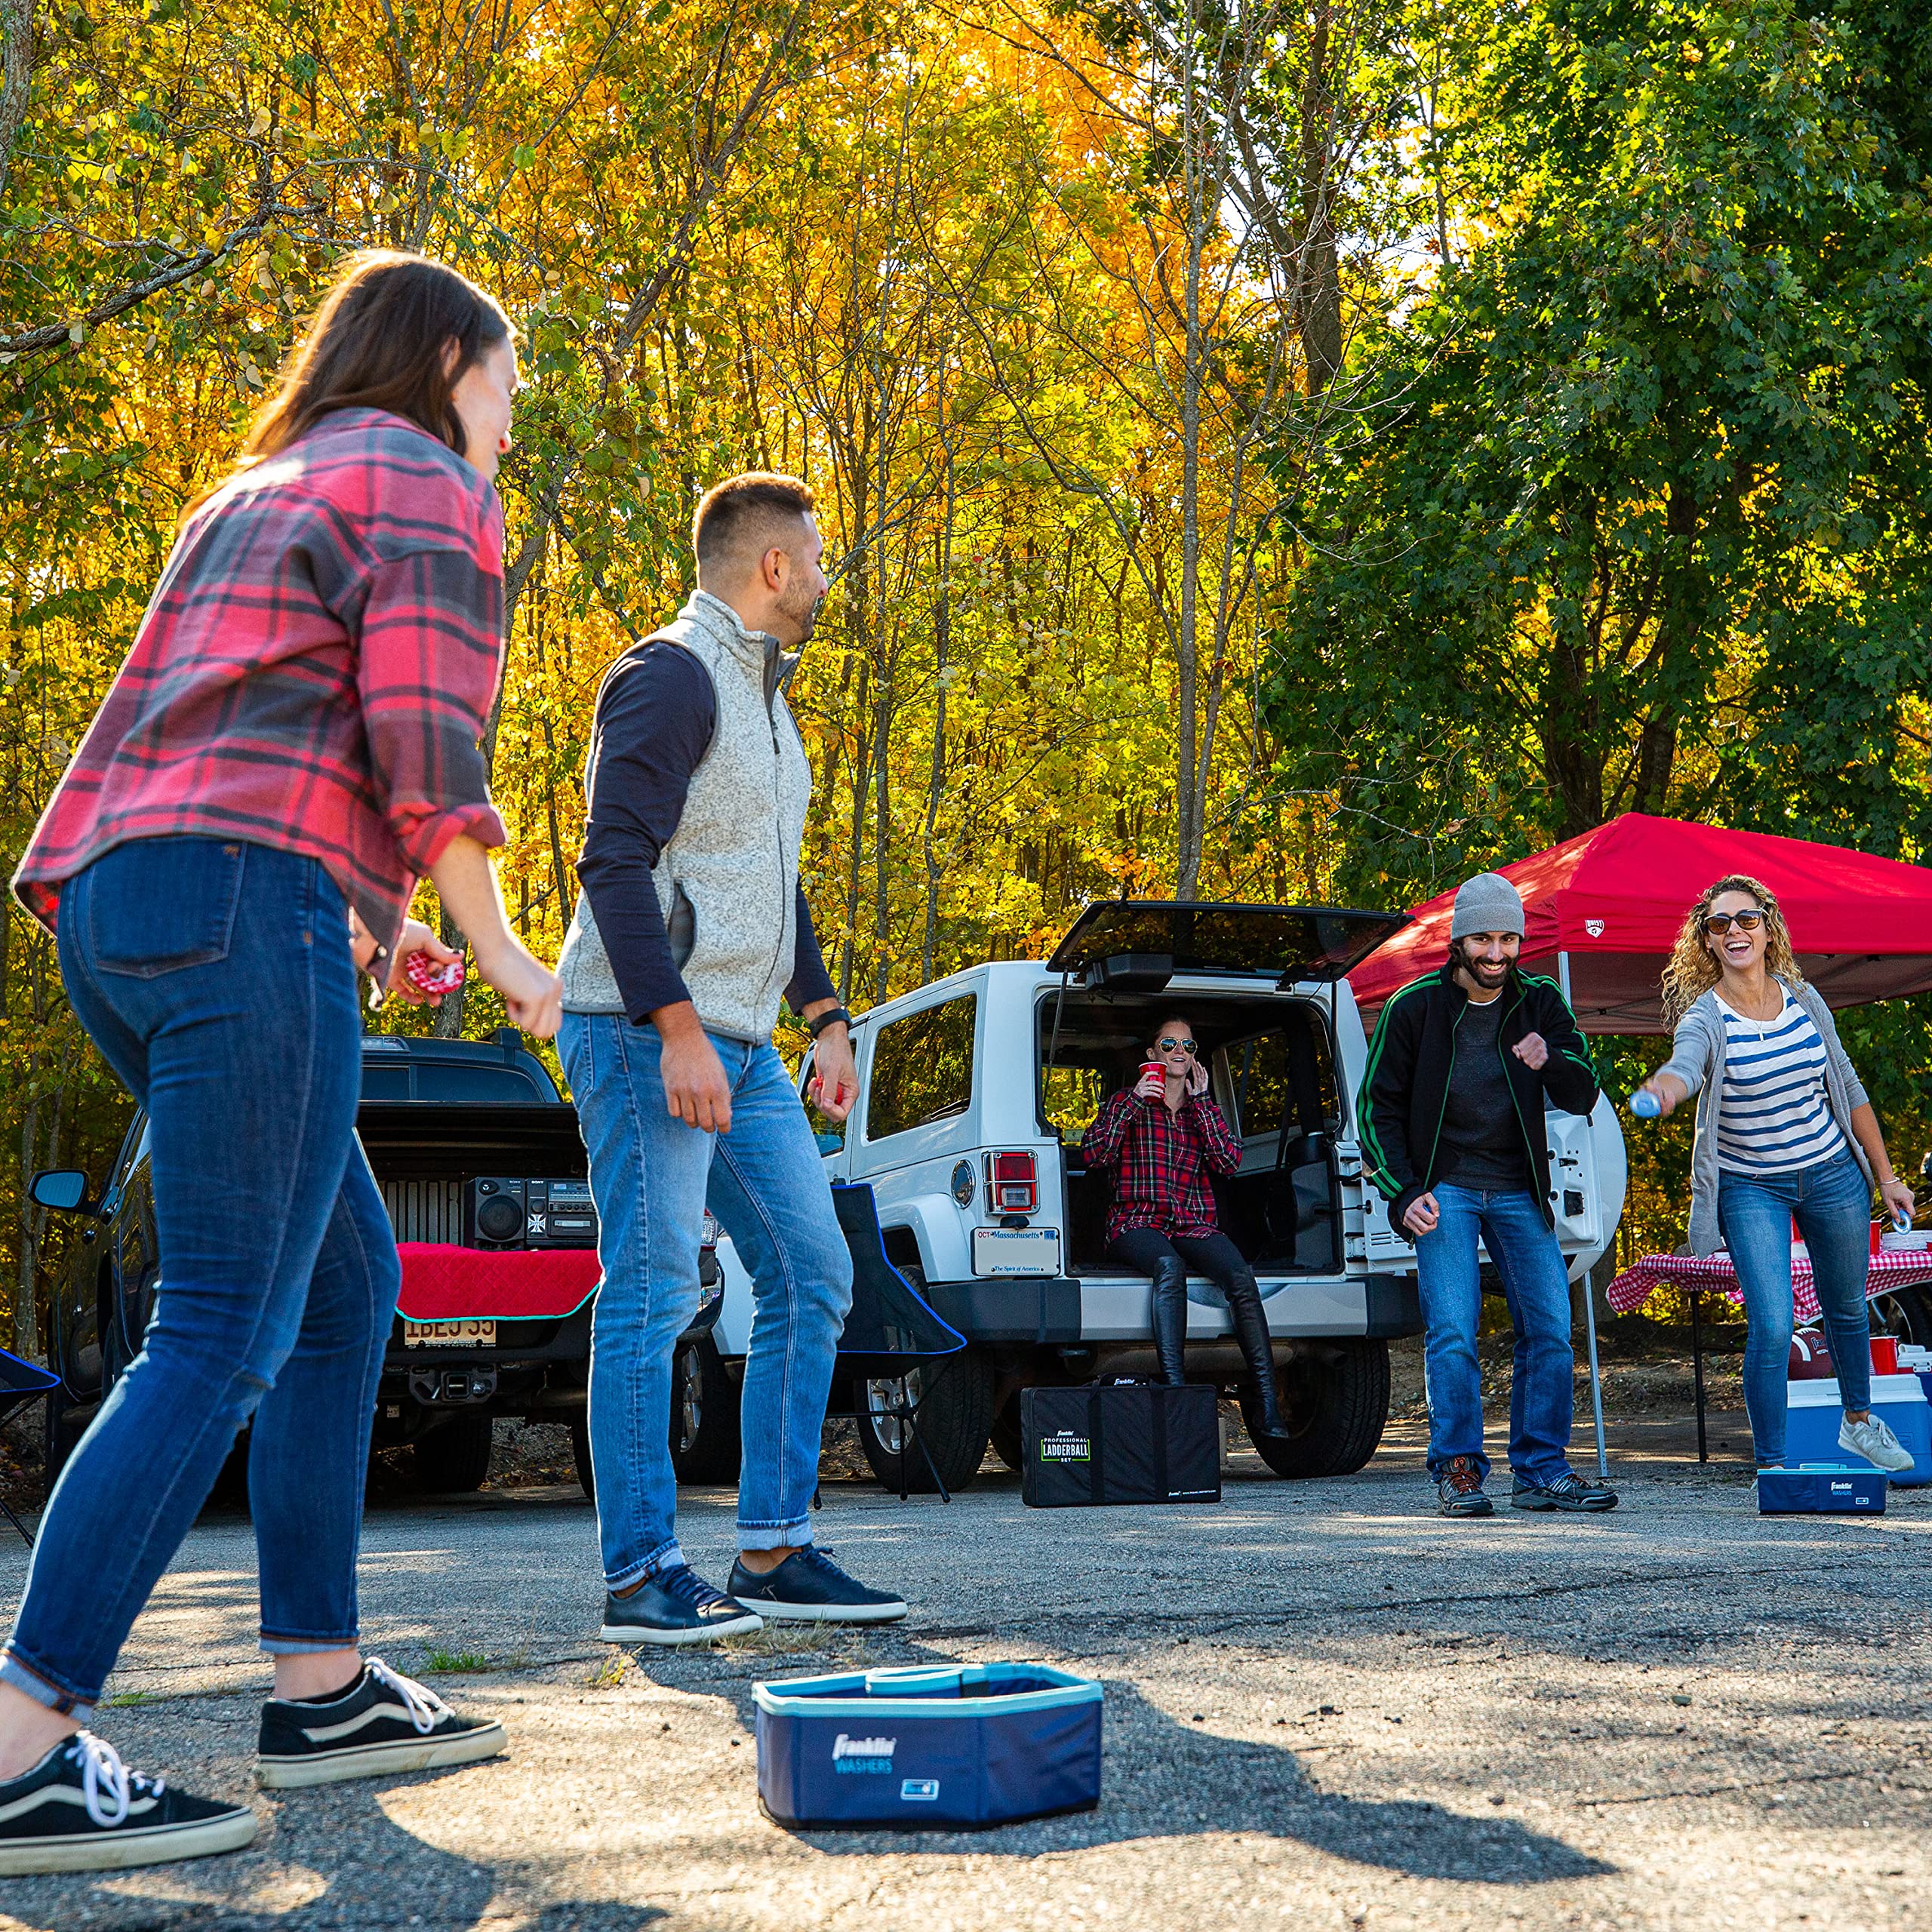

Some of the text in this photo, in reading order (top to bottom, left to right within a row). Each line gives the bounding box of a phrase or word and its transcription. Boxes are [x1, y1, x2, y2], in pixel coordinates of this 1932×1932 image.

[993, 1230, 1040, 1239] Massachusetts
[1043, 1444, 1088, 1457] LADDERBALL
[834, 1758, 894, 1774] WASHERS
